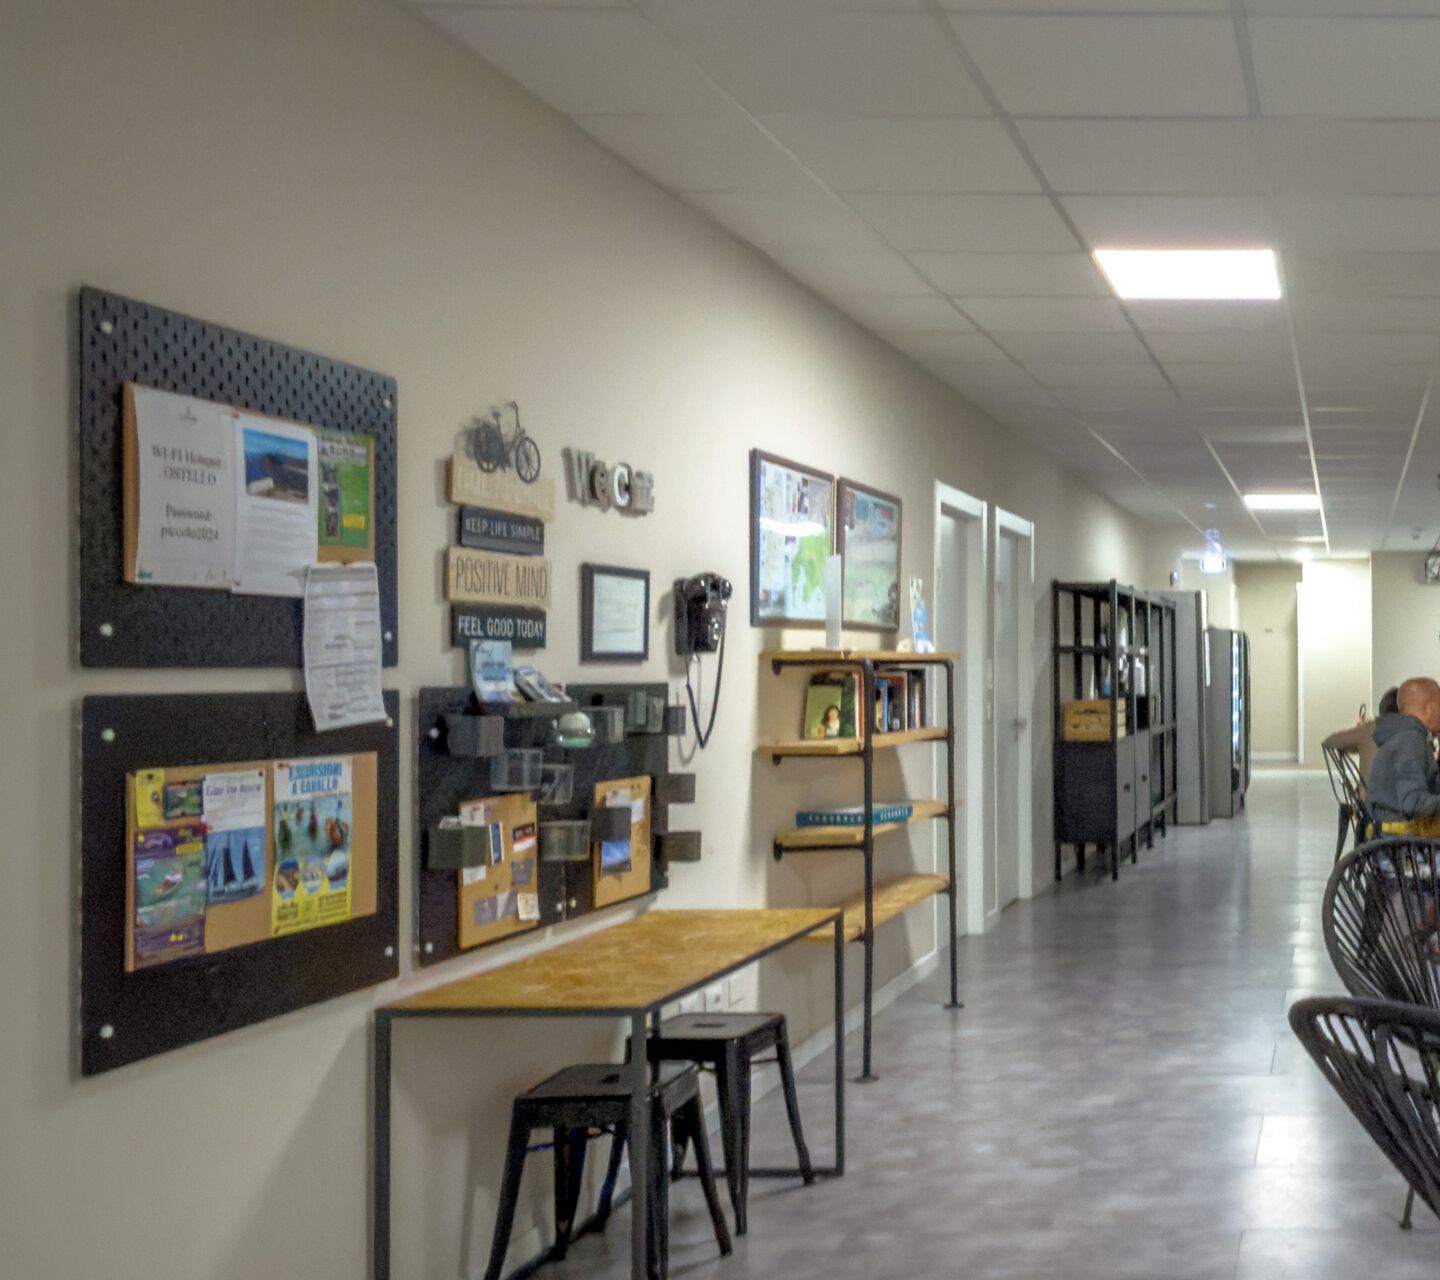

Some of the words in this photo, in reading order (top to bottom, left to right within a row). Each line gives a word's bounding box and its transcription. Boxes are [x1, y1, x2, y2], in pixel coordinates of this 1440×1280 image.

[464, 518, 488, 534] KEEP
[490, 521, 508, 537] LIFE
[511, 523, 541, 542] SIMPLE
[455, 557, 511, 596] POSITIVE
[515, 566, 548, 599] MIND
[458, 616, 484, 636] FEEL
[486, 618, 514, 638] GOOD
[516, 619, 544, 638] TODAY
